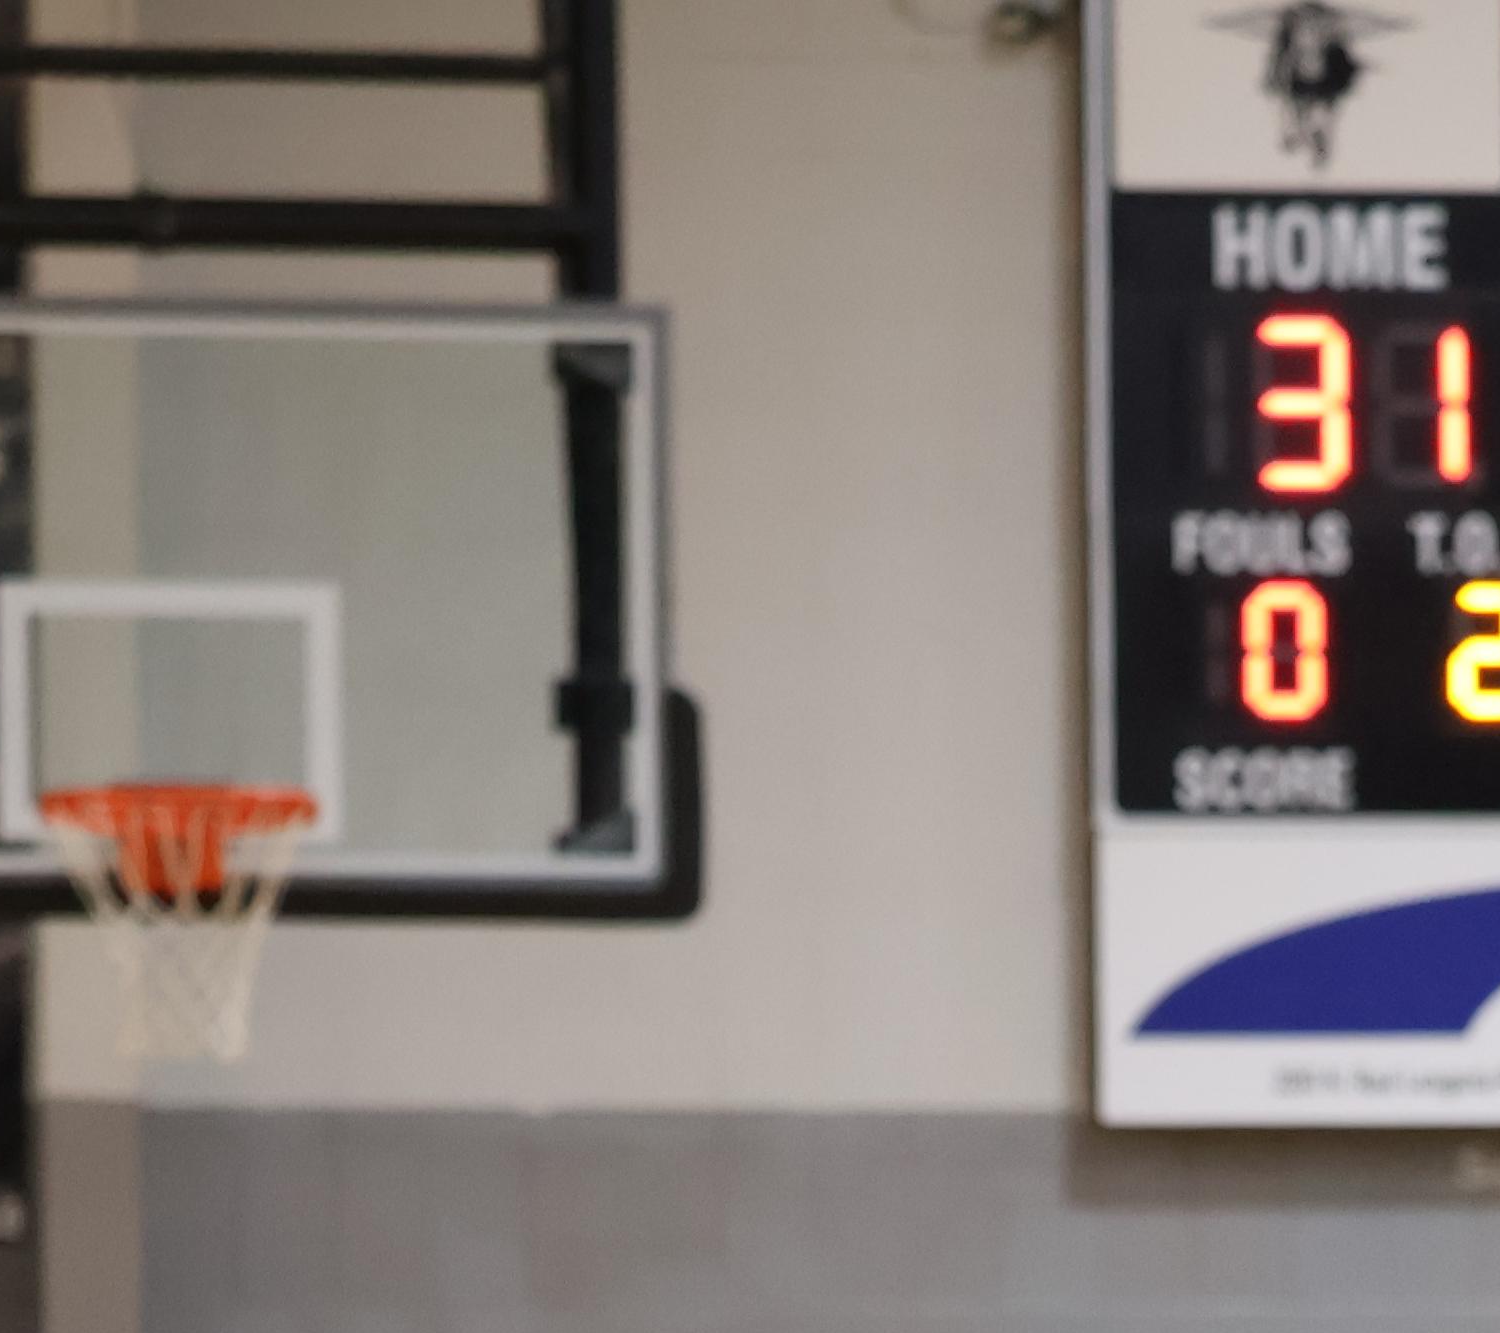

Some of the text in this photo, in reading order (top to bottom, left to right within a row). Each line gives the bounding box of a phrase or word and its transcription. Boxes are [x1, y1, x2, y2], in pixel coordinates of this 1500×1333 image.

[1210, 203, 1450, 292] HOME
[1255, 313, 1470, 495] 31
[1171, 511, 1353, 577] FOULS
[1240, 579, 1329, 721] 0
[1172, 746, 1356, 813] SCORE
